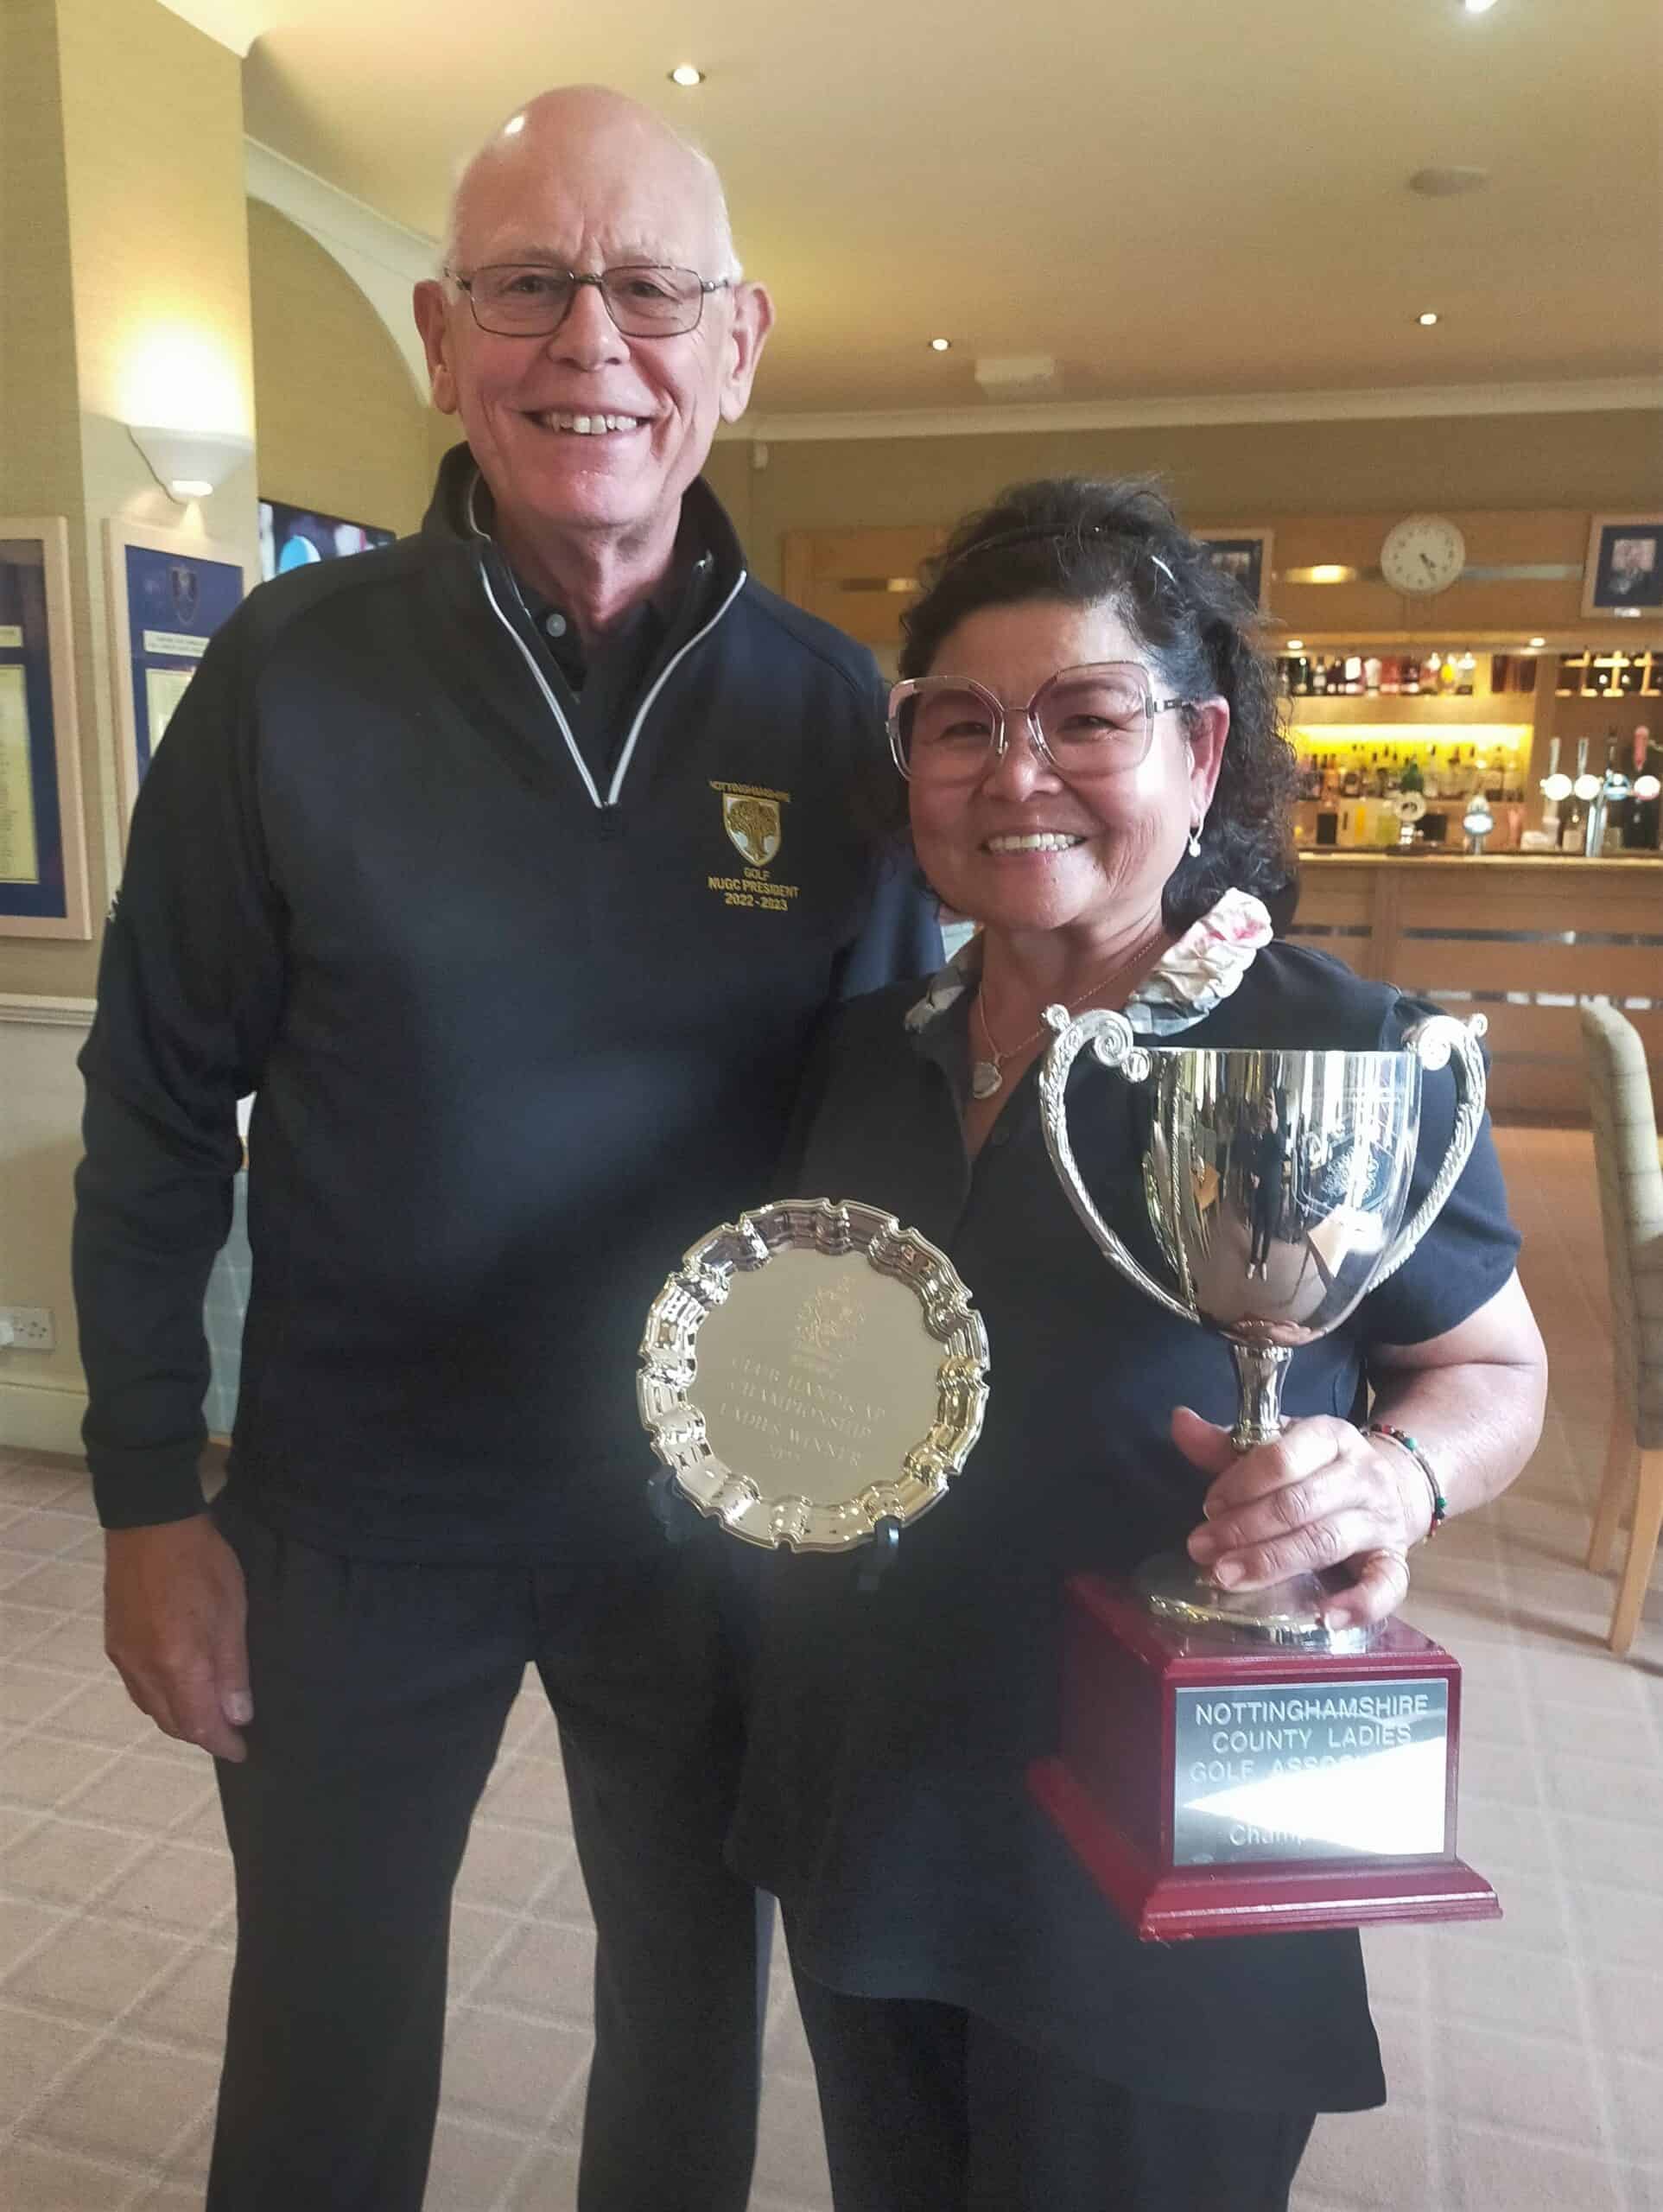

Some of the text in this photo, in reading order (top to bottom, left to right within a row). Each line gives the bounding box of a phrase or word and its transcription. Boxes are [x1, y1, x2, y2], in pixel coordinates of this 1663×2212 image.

[743, 867, 771, 881] GOLF
[708, 876, 801, 899] NUGC PRESIDENT
[1195, 1694, 1429, 1726] NOTTINGHAMSHIRE
[1212, 1722, 1412, 1754] COUNTY LADIES
[1190, 1759, 1255, 1783] GOLF
